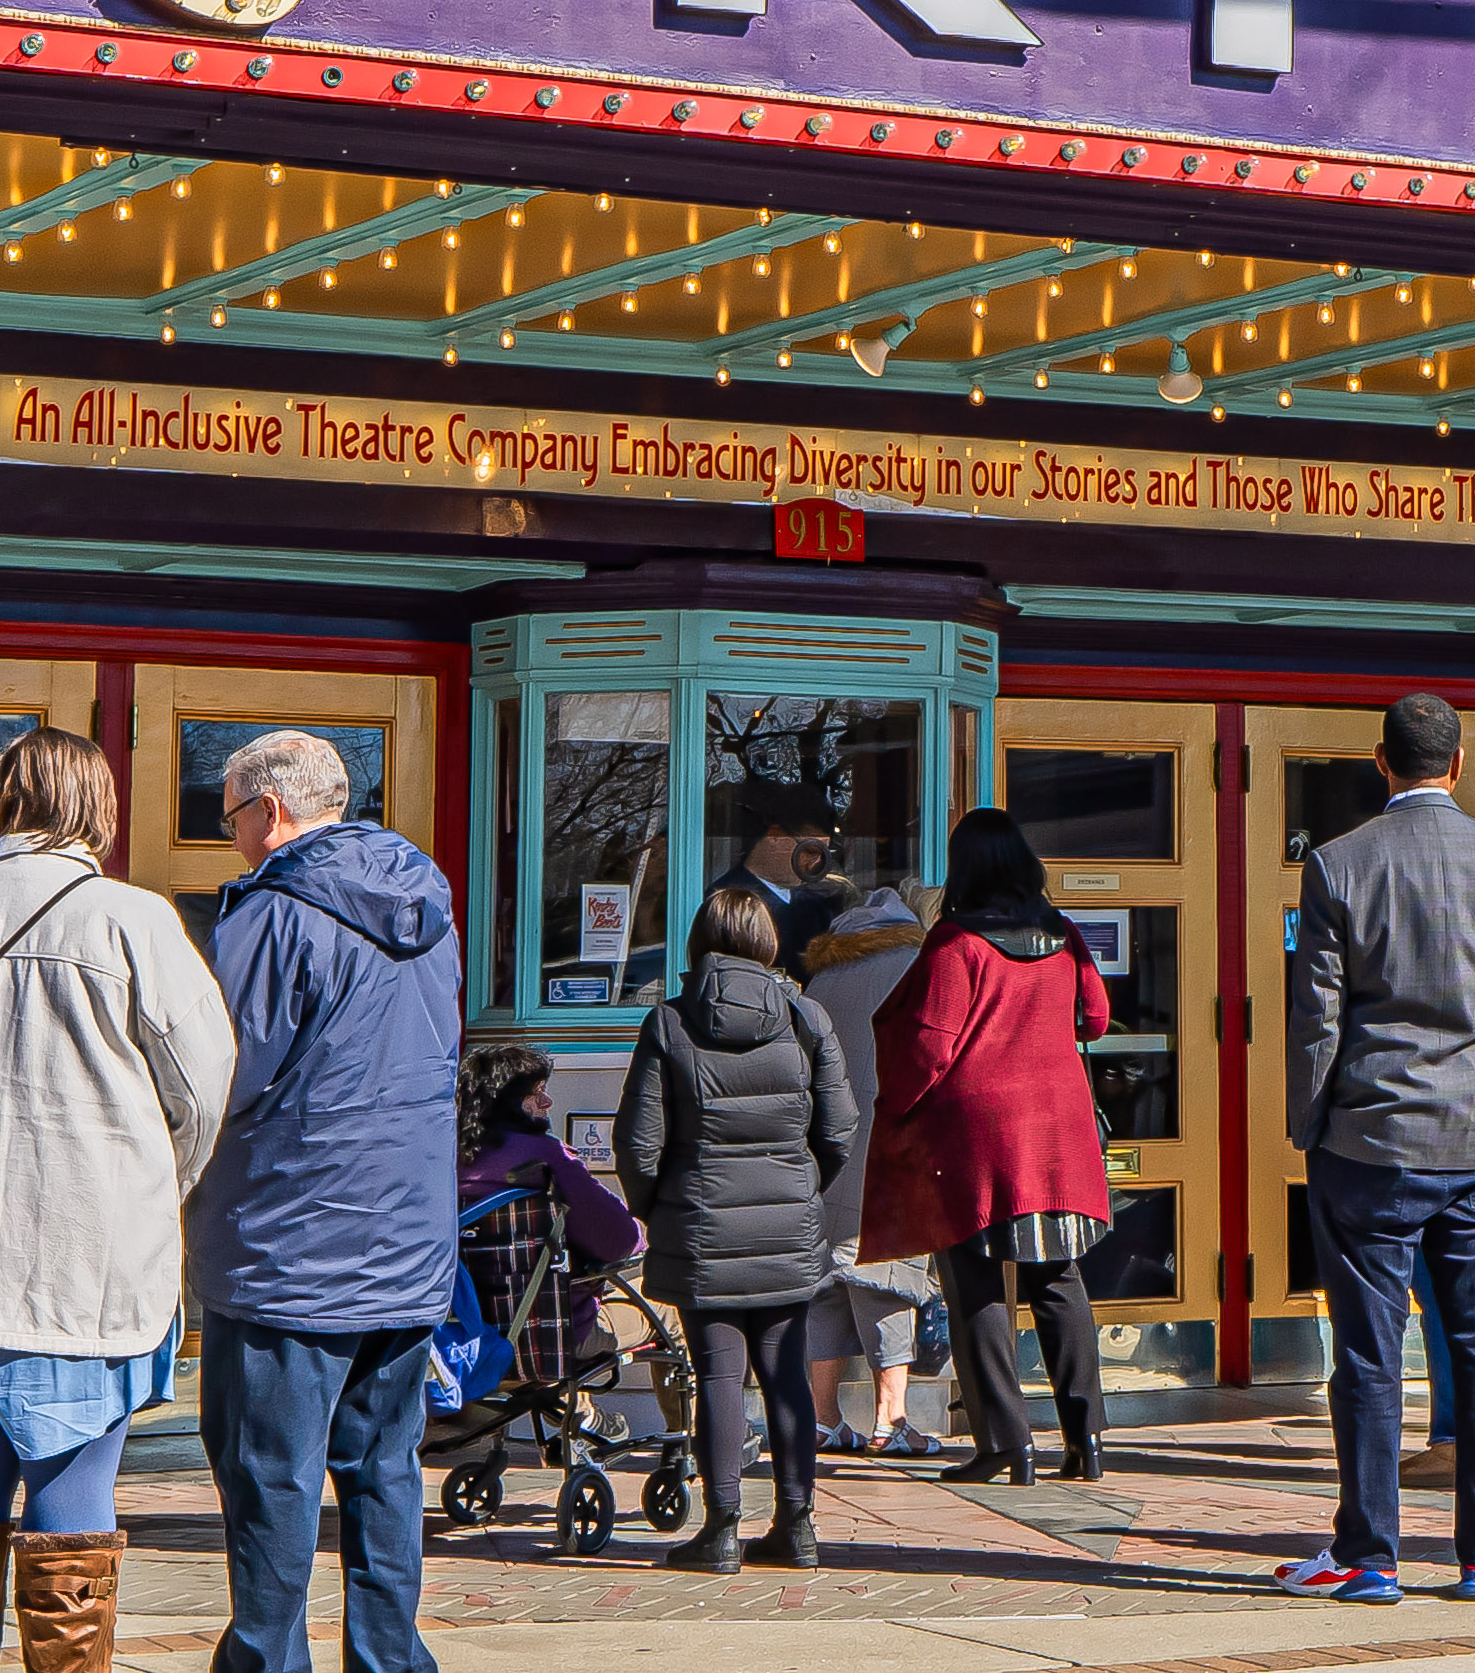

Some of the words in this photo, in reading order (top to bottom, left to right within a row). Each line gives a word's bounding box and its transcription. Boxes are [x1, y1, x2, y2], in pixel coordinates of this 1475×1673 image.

[14, 386, 61, 443] An
[71, 386, 283, 456] All-Inclusive
[296, 401, 434, 465] Theatre
[446, 413, 600, 487] Company
[610, 421, 777, 497] Embracing
[788, 432, 928, 507] Diversity
[935, 445, 962, 496] in
[970, 456, 1025, 499] our
[1031, 449, 1138, 505] Stories
[1146, 456, 1199, 509] and
[1205, 458, 1293, 513] Those
[1300, 464, 1359, 517] Who
[1366, 468, 1445, 524] Share
[787, 509, 855, 553] 915
